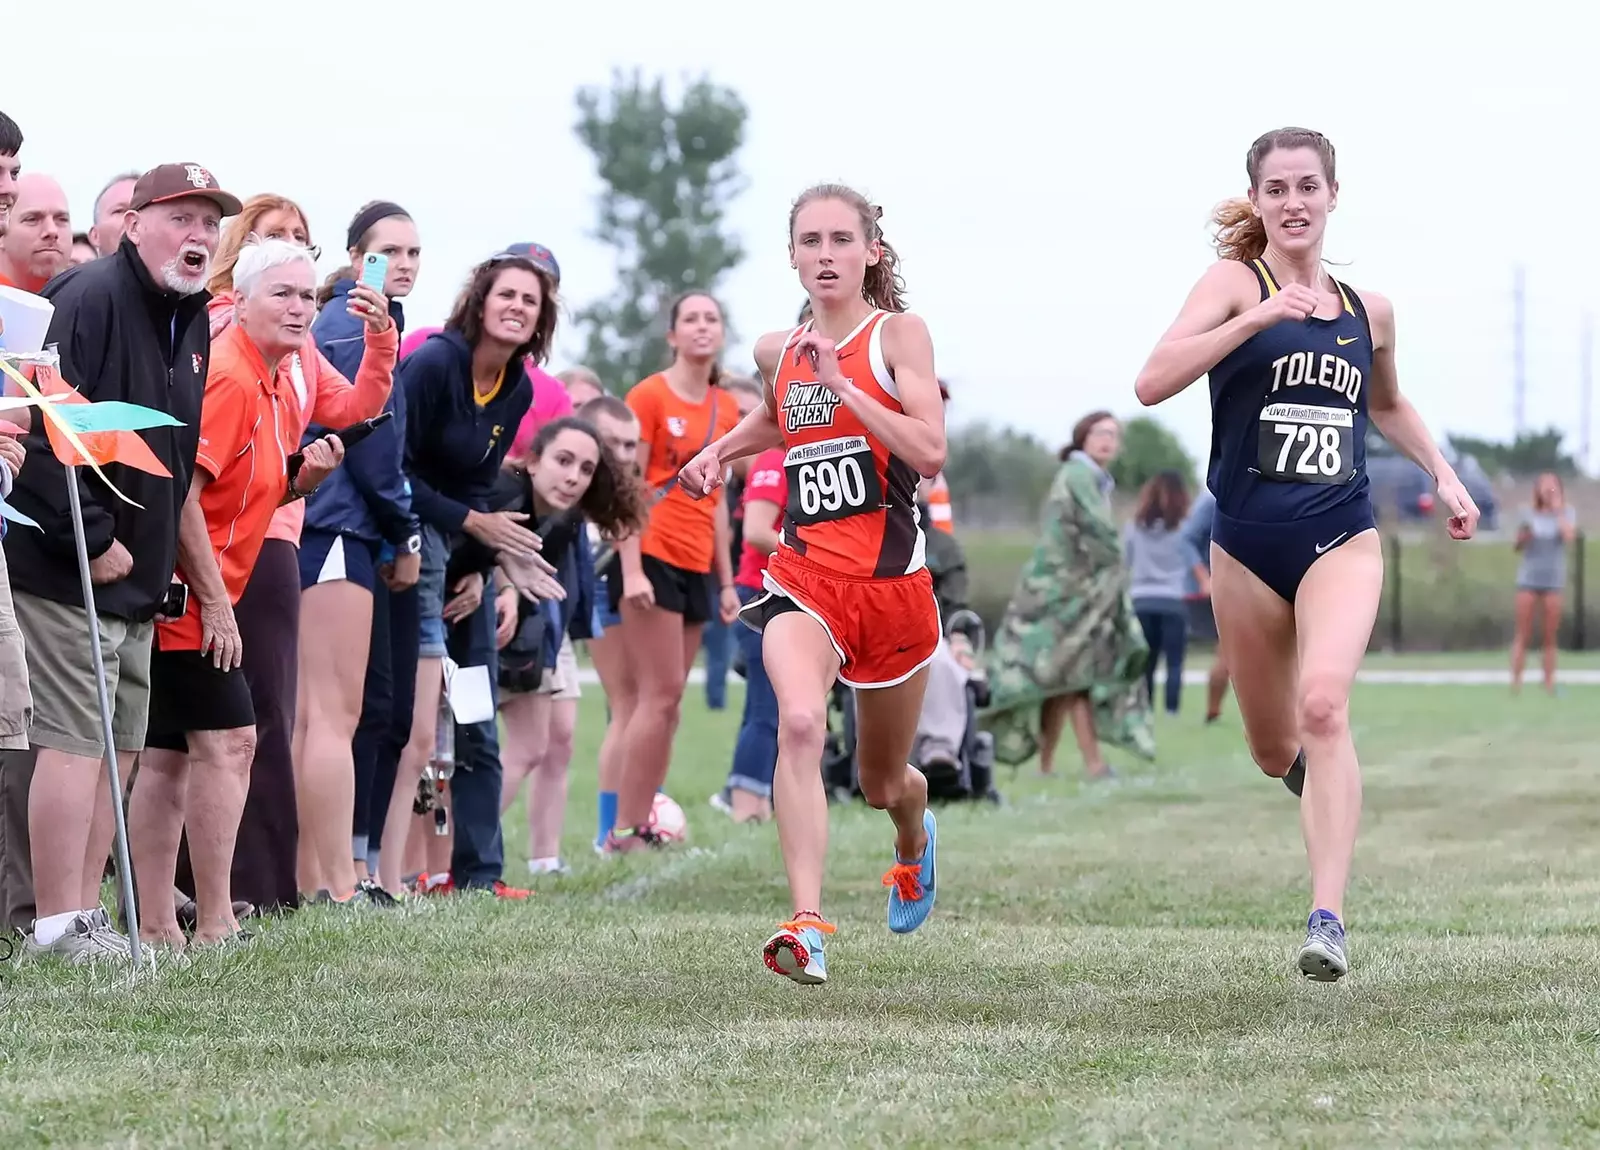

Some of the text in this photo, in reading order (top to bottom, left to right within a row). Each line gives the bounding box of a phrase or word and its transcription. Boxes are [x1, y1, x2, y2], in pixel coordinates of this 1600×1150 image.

[1272, 351, 1362, 404] TOLEDO
[788, 403, 833, 430] GREEN
[1274, 423, 1342, 476] 728
[798, 456, 866, 515] 690
